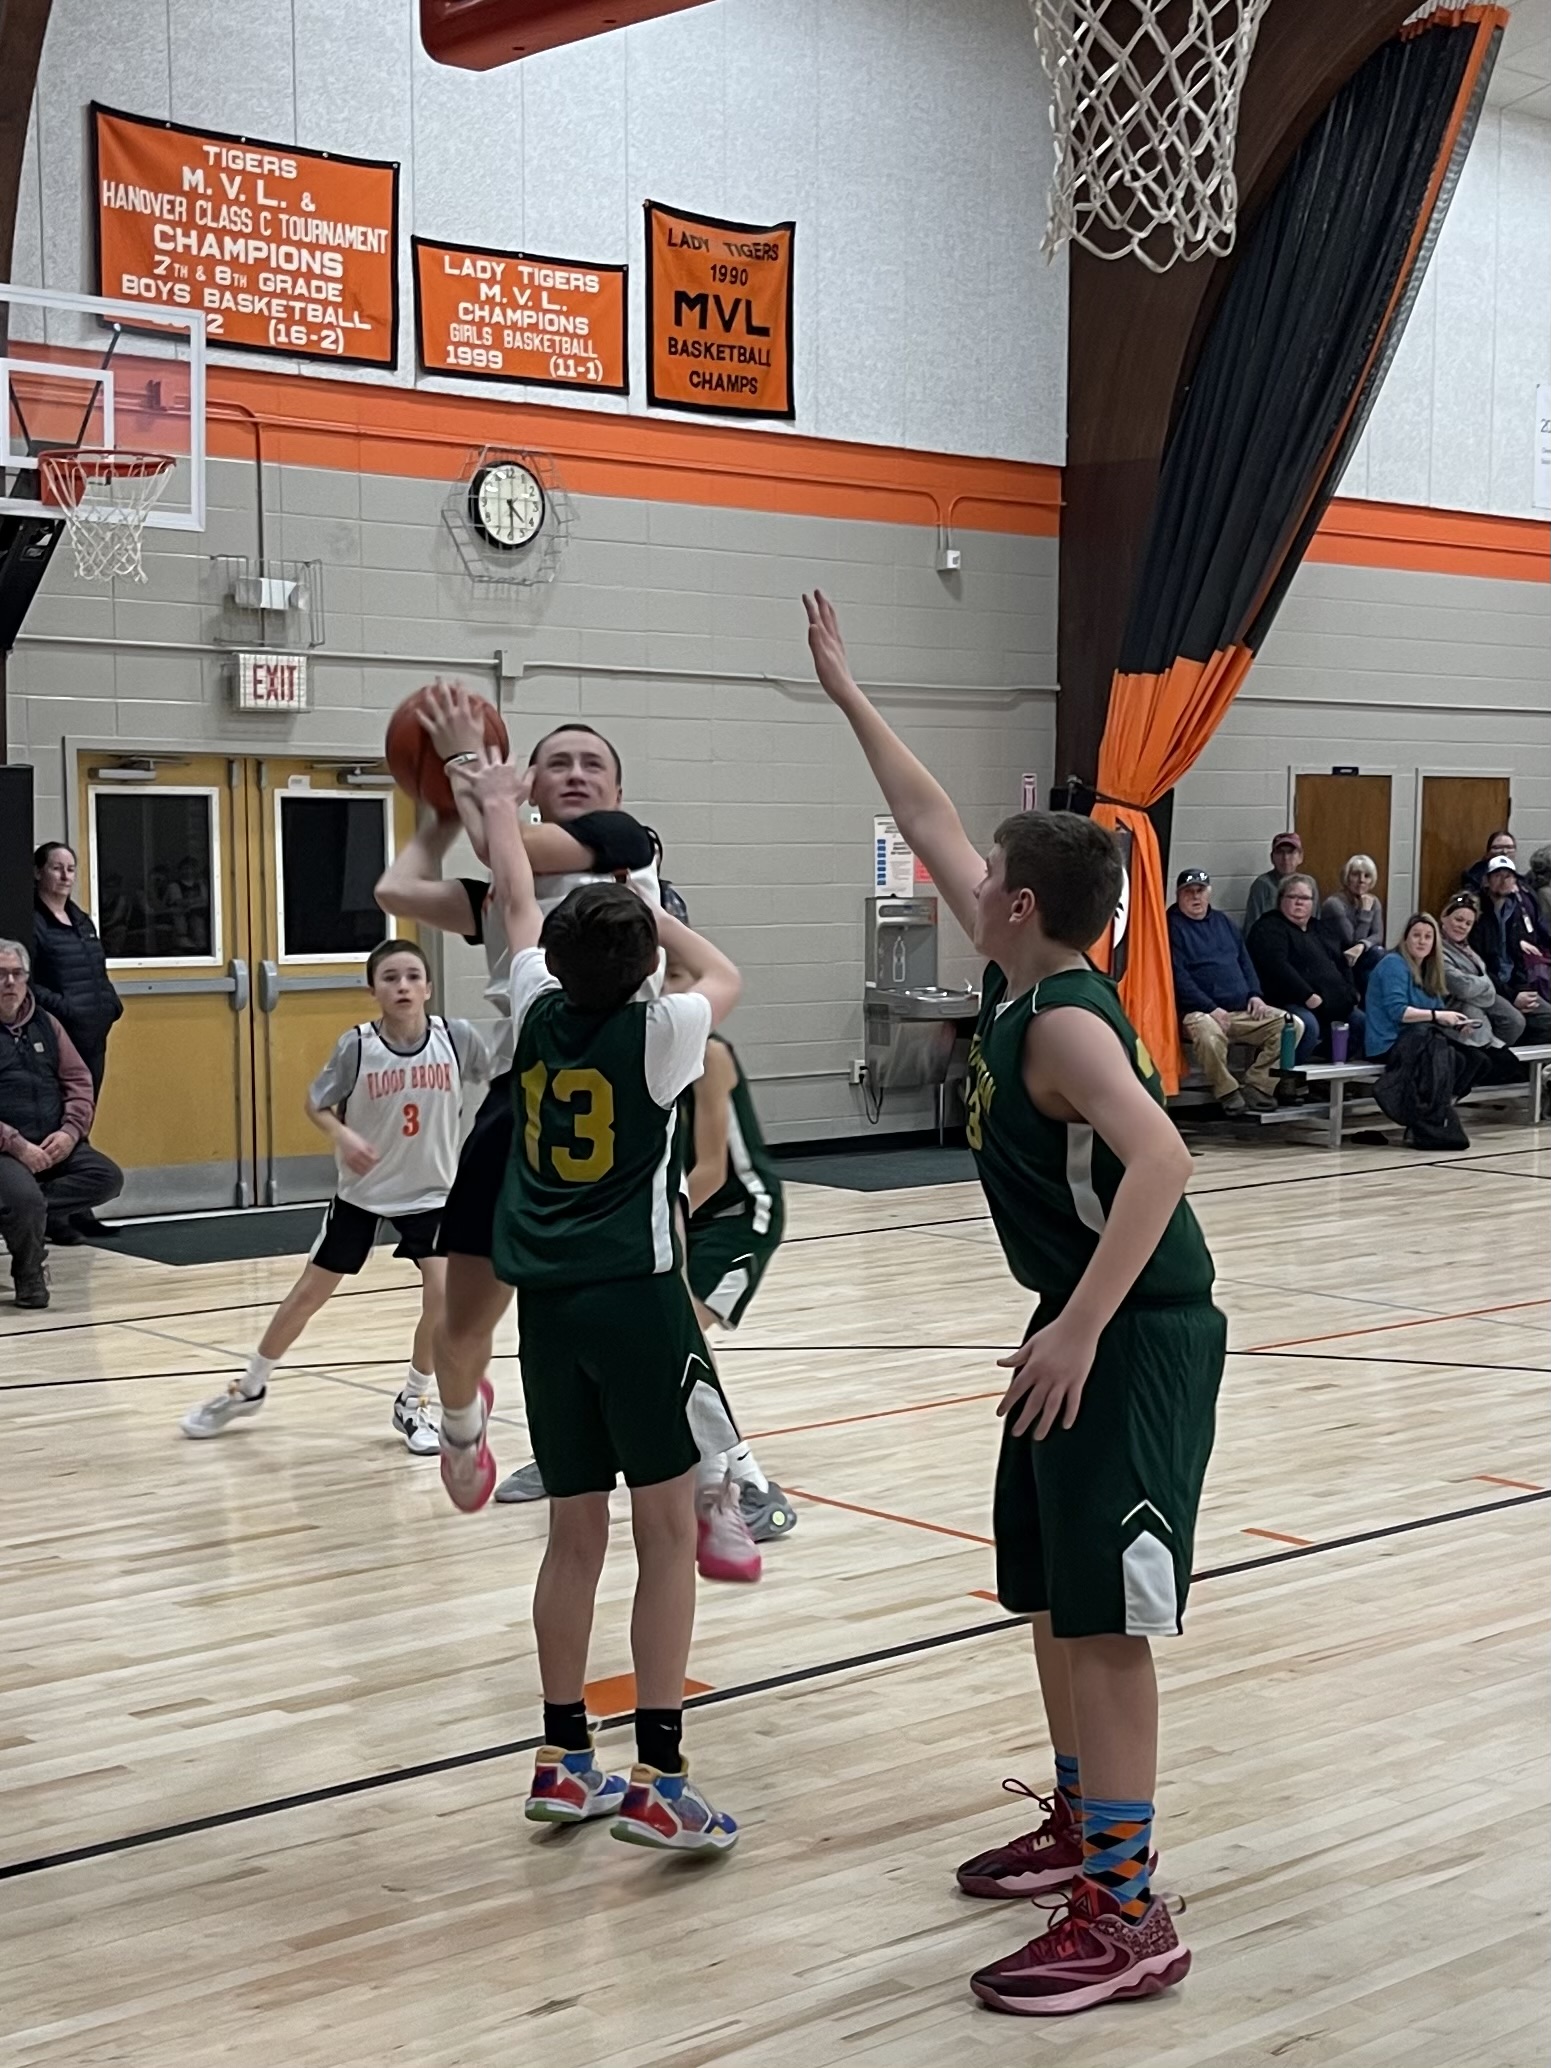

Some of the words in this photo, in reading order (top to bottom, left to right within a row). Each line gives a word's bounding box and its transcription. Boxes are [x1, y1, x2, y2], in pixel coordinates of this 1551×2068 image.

[202, 145, 297, 179] TIGERS
[182, 166, 212, 196] M.
[220, 173, 246, 201] V.
[256, 179, 287, 208] L.
[300, 192, 316, 212] &
[103, 180, 187, 222] HANOVER
[195, 200, 253, 233] CLASS
[259, 214, 272, 236] C
[278, 214, 389, 254] TOURNAMENT
[153, 223, 344, 278] CHAMPIONS
[667, 228, 710, 253] LADY
[723, 242, 779, 262] TIGERS
[195, 265, 207, 281] &
[258, 272, 344, 302] GRADE
[444, 255, 506, 281] LADY
[518, 265, 600, 293] TIGERS
[710, 264, 749, 286] 1990
[122, 274, 191, 304] BOYS
[203, 288, 372, 330] BASKETBALL
[479, 283, 507, 304] M.
[512, 287, 533, 307] V.
[541, 290, 568, 312] L.
[674, 290, 771, 337] MVL
[268, 318, 344, 354] (16-2)
[458, 302, 589, 336] CHAMPIONS
[450, 323, 492, 346] GIRLS
[503, 329, 598, 358] BASKETBALL
[668, 337, 771, 367] BASKETBALL
[446, 345, 503, 369] 1999
[550, 356, 603, 382] (11-1)
[689, 370, 758, 394] CHAMPS
[253, 664, 297, 701] EXIT
[402, 1103, 419, 1137] 3
[521, 1059, 615, 1183] 13
